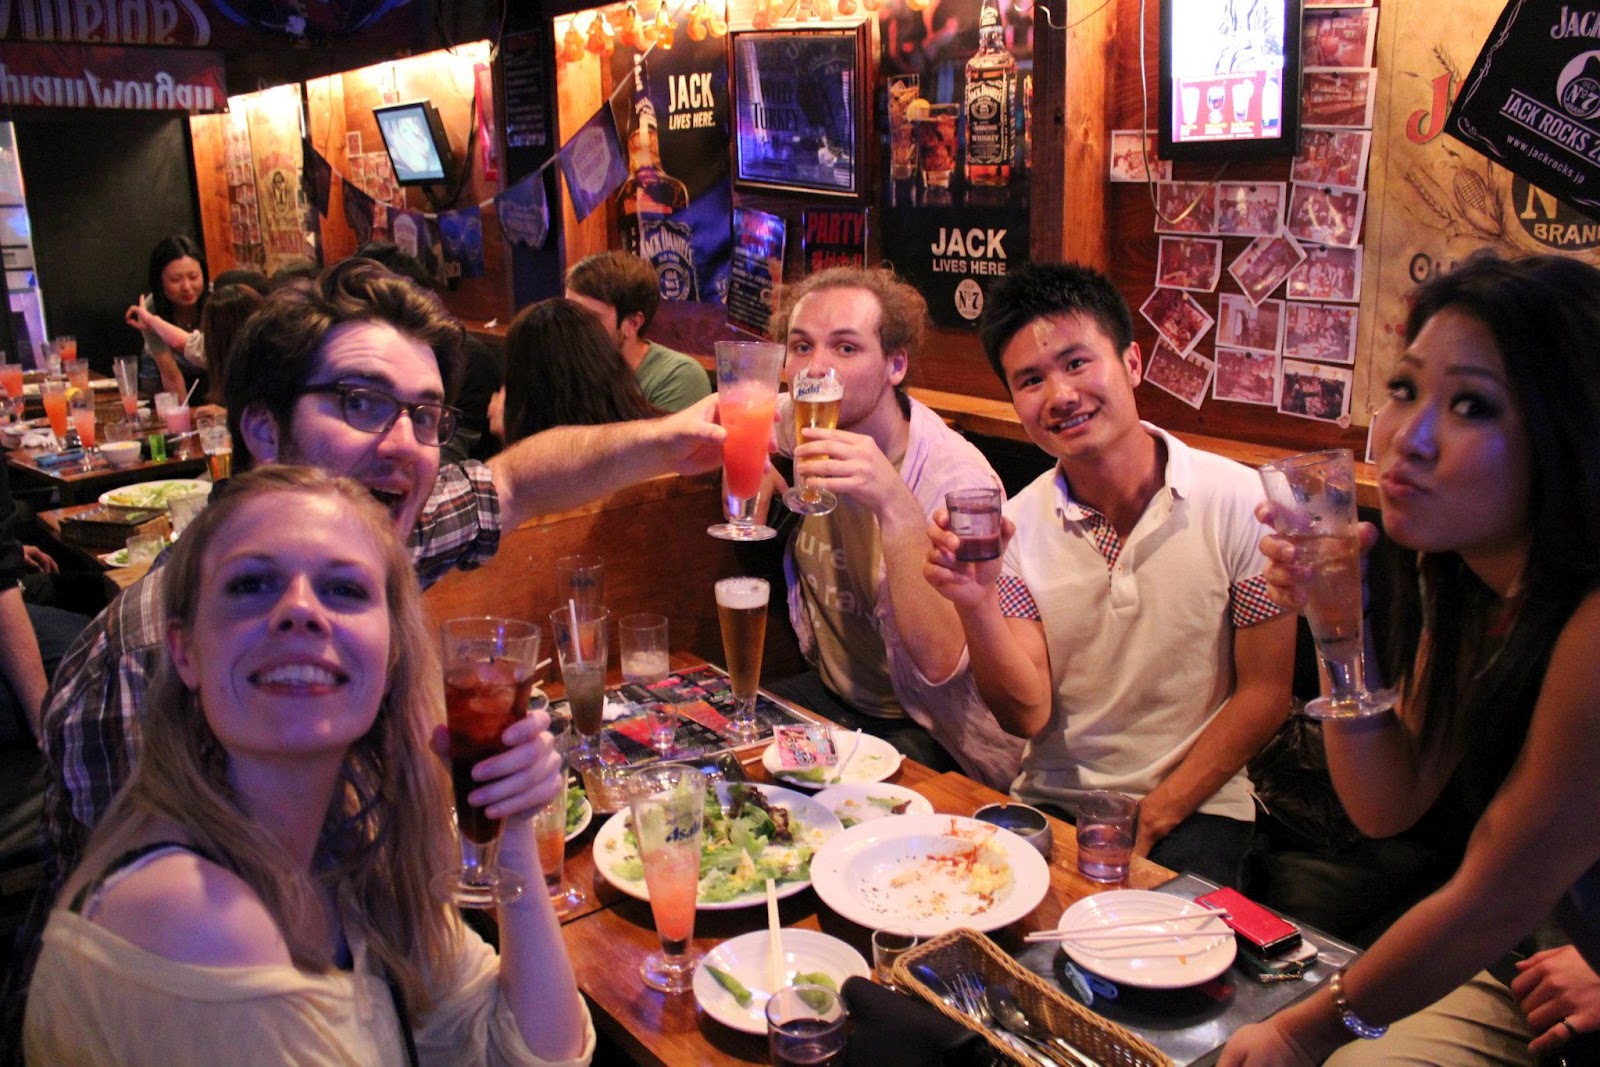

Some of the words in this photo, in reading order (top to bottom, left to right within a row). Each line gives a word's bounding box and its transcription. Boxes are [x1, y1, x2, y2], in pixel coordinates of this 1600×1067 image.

[668, 72, 715, 113] JACK
[668, 113, 692, 131] LIVES
[692, 110, 716, 128] HERE.
[1501, 93, 1541, 126] JACK
[1538, 112, 1591, 152] ROCKS
[805, 211, 864, 246] PARTY
[931, 227, 1008, 260] JACK
[932, 259, 967, 274] LIVES
[970, 260, 1007, 276] HERE
